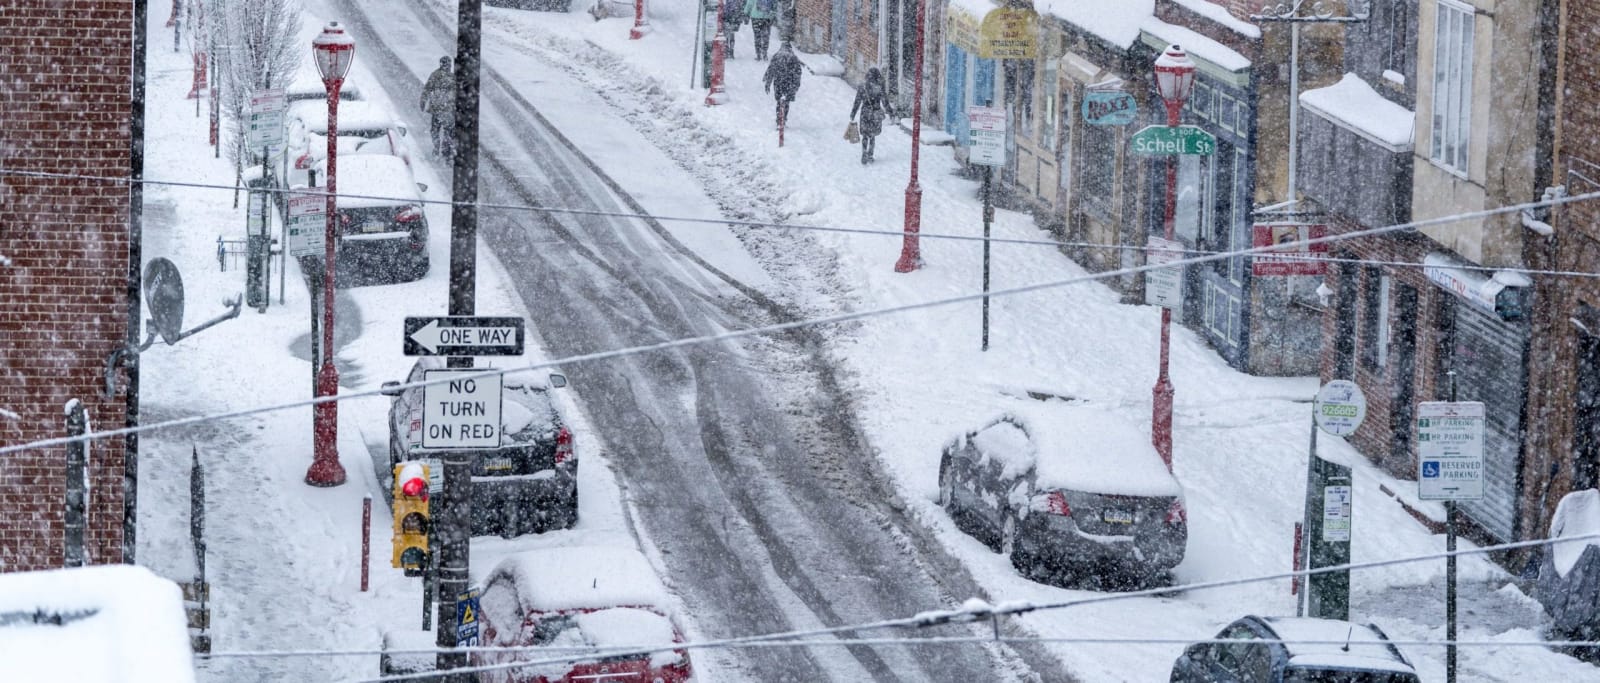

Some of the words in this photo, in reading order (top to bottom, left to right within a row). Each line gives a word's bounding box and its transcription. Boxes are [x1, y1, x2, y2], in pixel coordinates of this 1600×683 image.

[1136, 137, 1186, 153] Schell
[1196, 140, 1210, 153] St
[440, 329, 472, 344] ONE
[478, 329, 511, 344] WAY
[449, 379, 477, 394] NO
[440, 401, 486, 417] TURN
[429, 424, 453, 439] ON
[460, 424, 494, 439] RED
[1444, 433, 1474, 441] PARKING
[1442, 461, 1480, 470] RESERVED
[1444, 471, 1479, 479] PARKING
